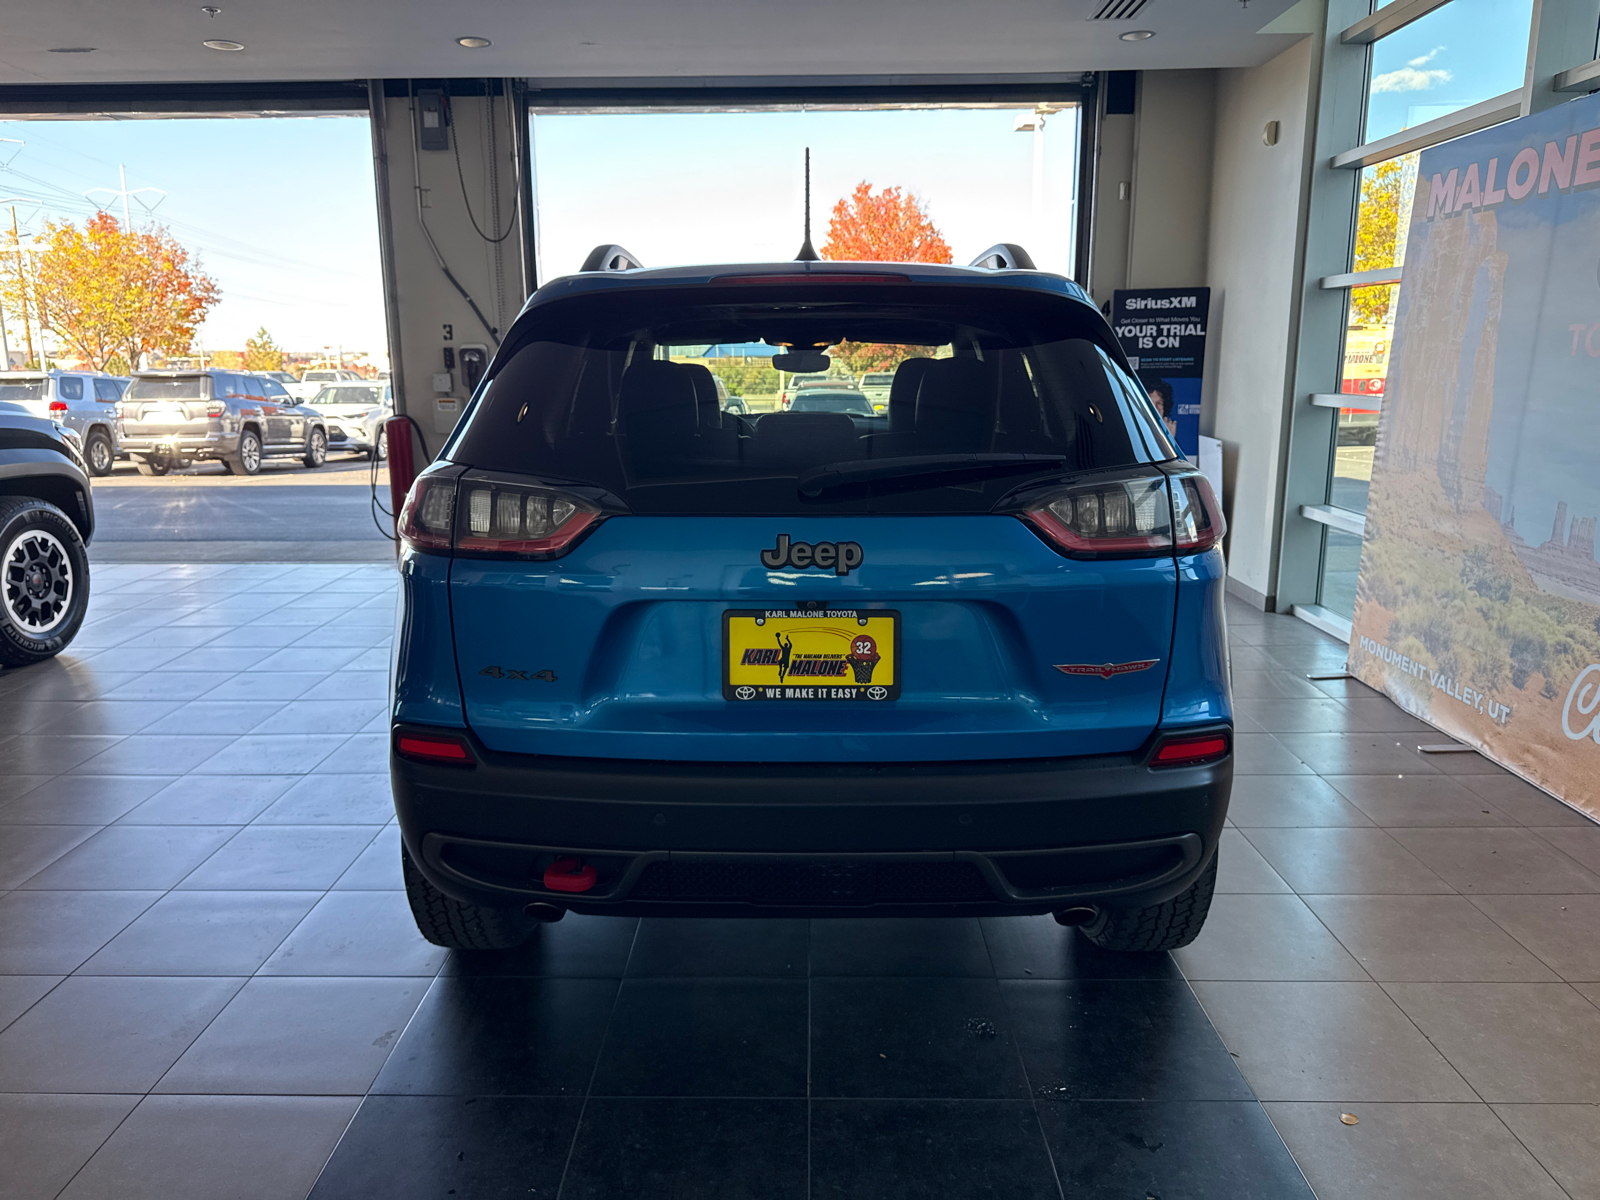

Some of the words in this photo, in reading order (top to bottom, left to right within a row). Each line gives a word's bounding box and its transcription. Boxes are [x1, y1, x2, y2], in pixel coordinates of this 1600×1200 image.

[1426, 128, 1600, 222] MALONE
[1101, 299, 1111, 317] 4
[1125, 296, 1197, 310] SiriusXM
[443, 324, 453, 341] 3
[1115, 325, 1157, 338] YOUR
[1160, 324, 1206, 336] TRIAL
[1138, 337, 1153, 349] IS
[1156, 336, 1180, 348] ON
[43, 511, 79, 541] MICHELIN
[761, 533, 863, 576] Jeep
[826, 610, 858, 618] TOYOTA
[5, 625, 46, 651] MICHELIN
[855, 641, 872, 655] 32
[740, 648, 782, 666] KARL
[479, 665, 558, 682] 4x4
[787, 659, 848, 677] MALONE
[1359, 634, 1427, 680] MONUMENT
[1429, 669, 1485, 715] VALLEY,
[1487, 699, 1511, 724] UT
[765, 688, 782, 698] WE
[785, 688, 814, 698] MAKE
[818, 688, 828, 698] IT
[832, 688, 858, 698] EASY
